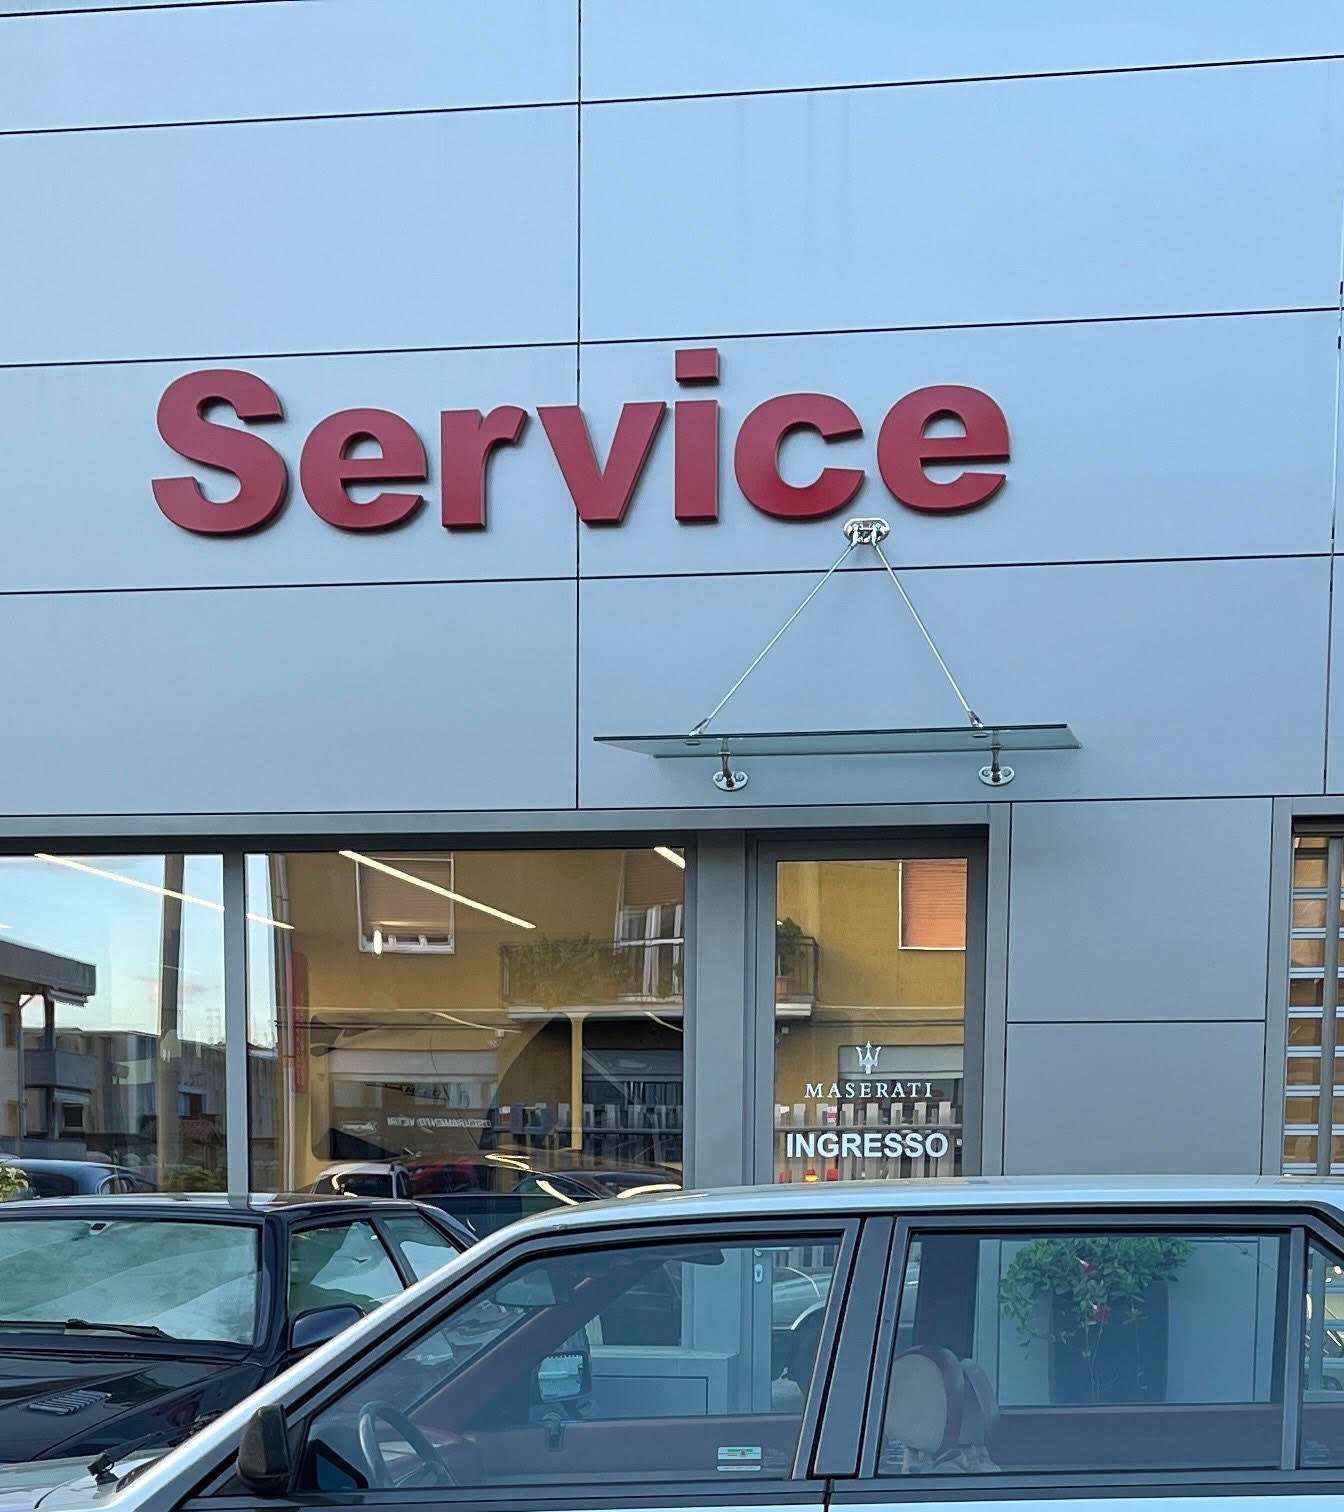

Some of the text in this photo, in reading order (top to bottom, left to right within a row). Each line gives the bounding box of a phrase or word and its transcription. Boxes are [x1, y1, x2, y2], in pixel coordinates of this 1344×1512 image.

[151, 347, 1011, 534] Service
[804, 1082, 933, 1098] MASERATI
[786, 1132, 949, 1158] INGRESSO
